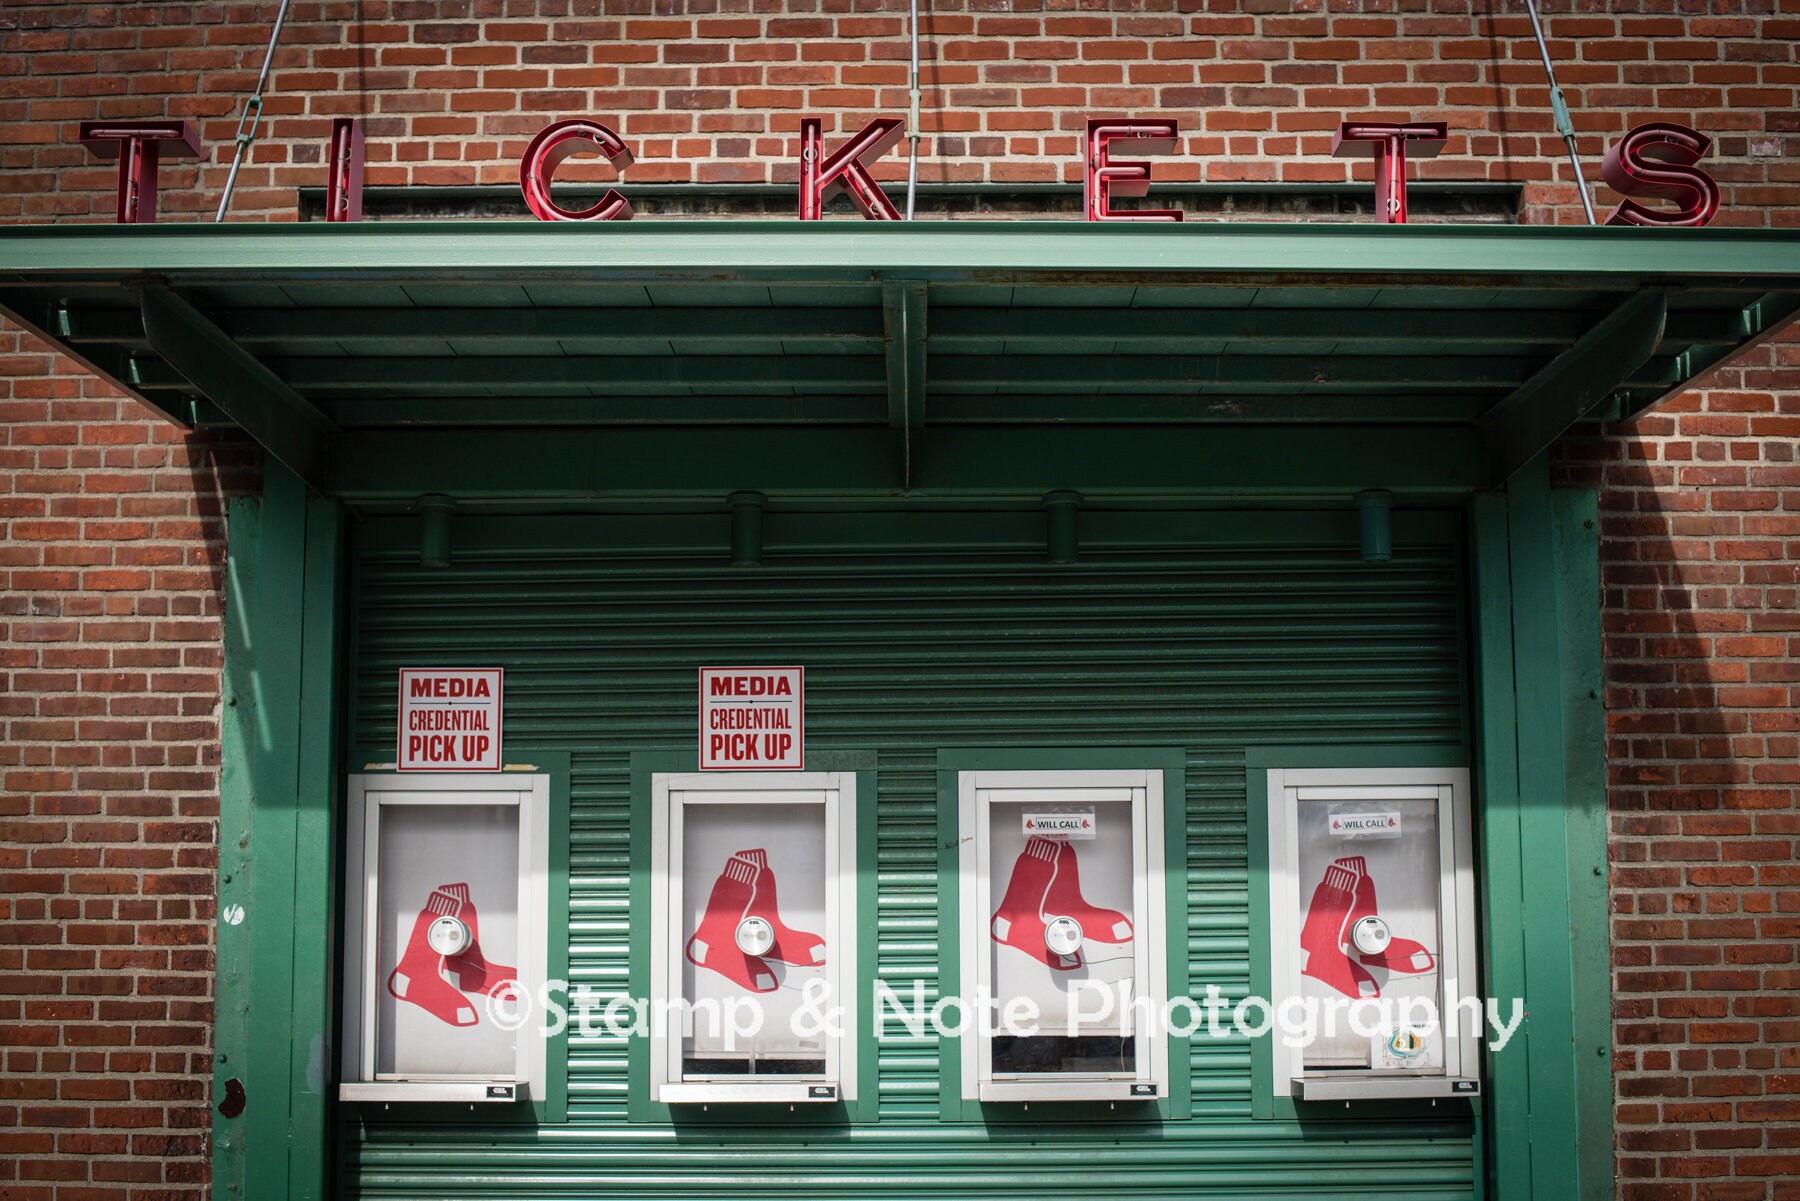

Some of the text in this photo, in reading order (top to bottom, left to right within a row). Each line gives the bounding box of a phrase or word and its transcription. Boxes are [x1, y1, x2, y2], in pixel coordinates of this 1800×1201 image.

[79, 118, 1721, 226] TICKETS
[409, 678, 491, 698] MEDIA
[710, 676, 792, 696] MEDIA
[408, 710, 490, 732] CREDENTIAL
[709, 708, 792, 730] CREDENTIAL
[408, 735, 490, 763] PICK UP
[709, 733, 792, 761] PICK UP
[1037, 820, 1080, 829] WILL CALL
[1344, 820, 1386, 829] WILL CALL
